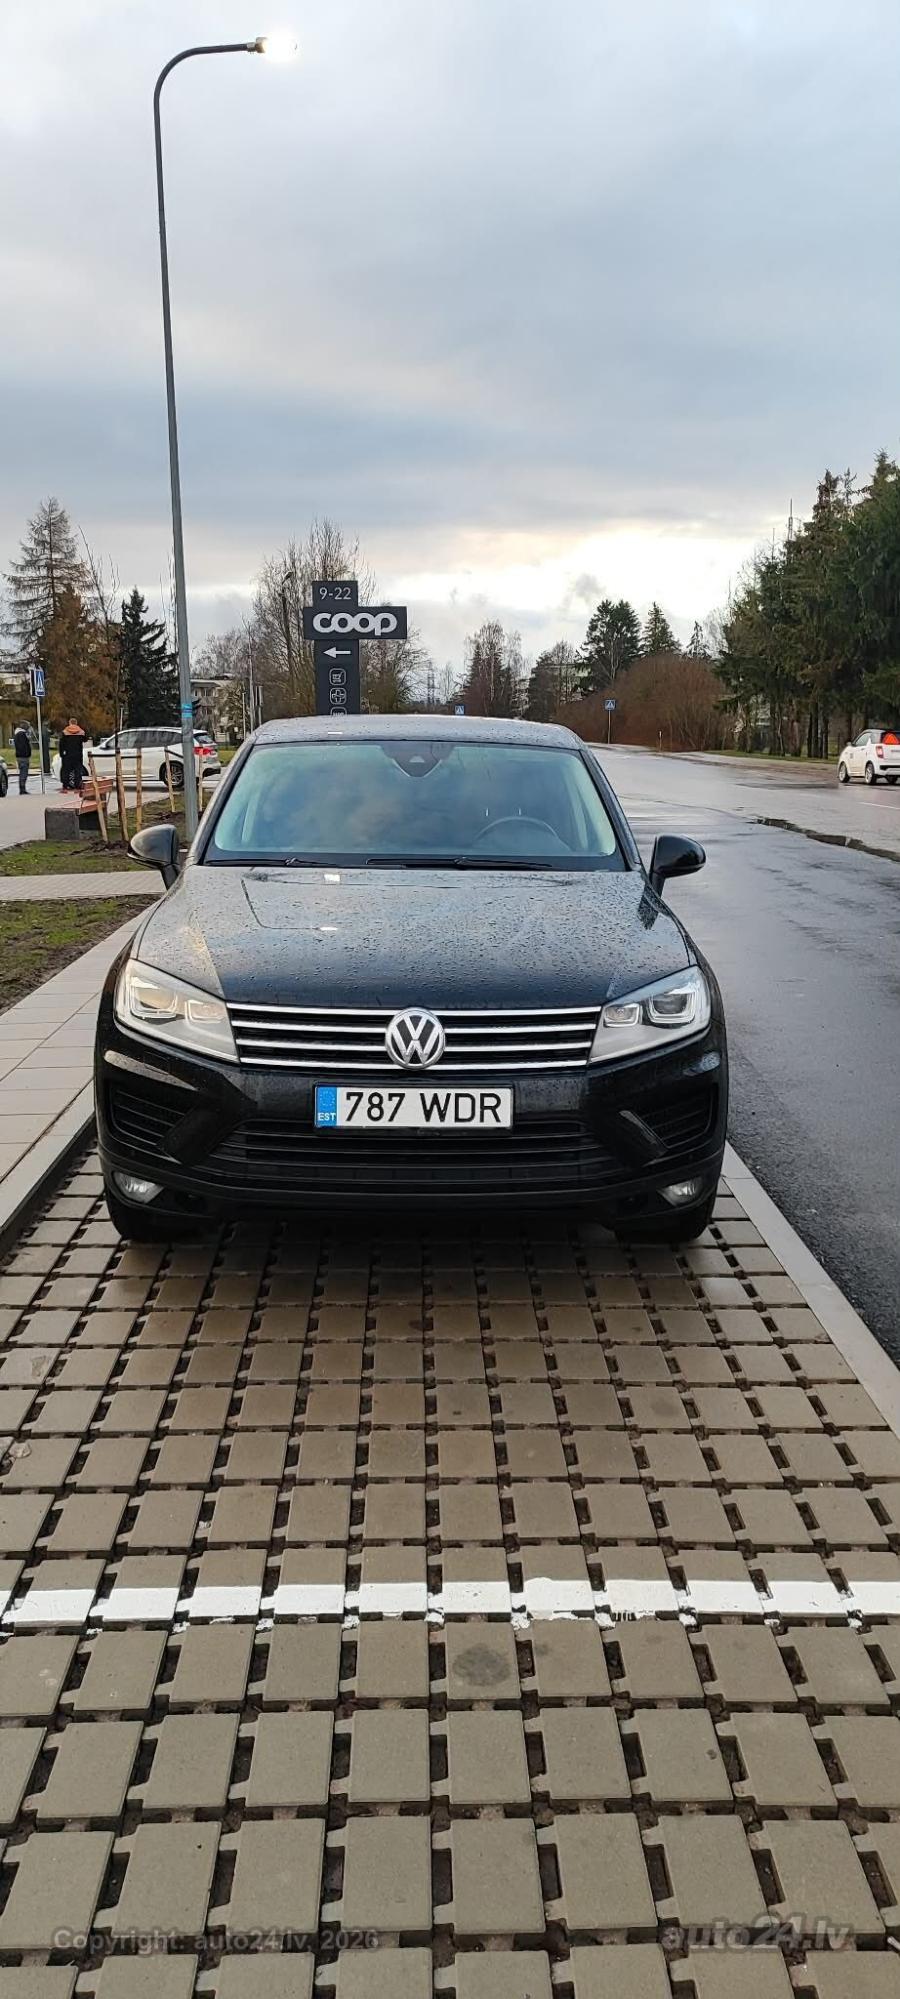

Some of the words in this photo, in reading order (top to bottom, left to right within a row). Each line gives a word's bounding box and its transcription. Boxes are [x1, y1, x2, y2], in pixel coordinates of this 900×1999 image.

[319, 587, 351, 600] 9-22
[313, 613, 397, 635] coop
[345, 1091, 406, 1122] 787
[419, 1092, 501, 1123] WDR
[317, 1112, 336, 1121] EST
